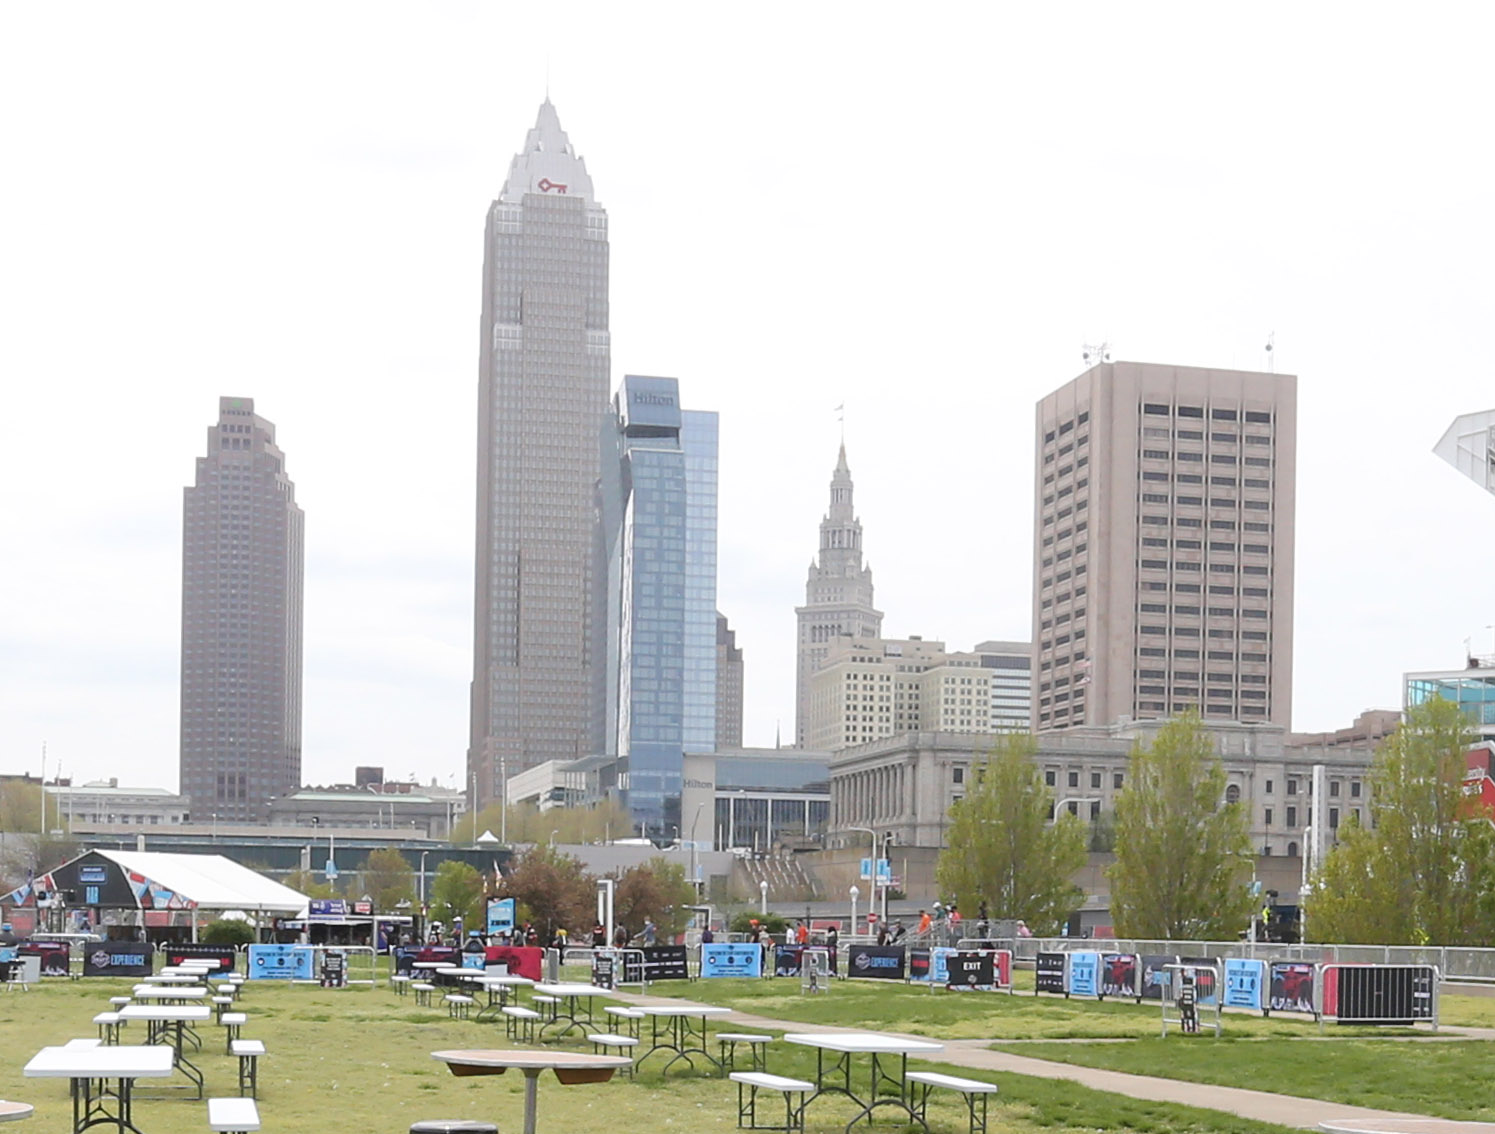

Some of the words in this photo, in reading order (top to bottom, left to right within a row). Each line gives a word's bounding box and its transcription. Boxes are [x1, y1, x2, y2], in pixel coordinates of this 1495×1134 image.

[634, 392, 673, 406] Hilton
[683, 779, 713, 789] Hilton
[110, 954, 145, 967] EXPERIENCE
[963, 961, 982, 971] EXIT
